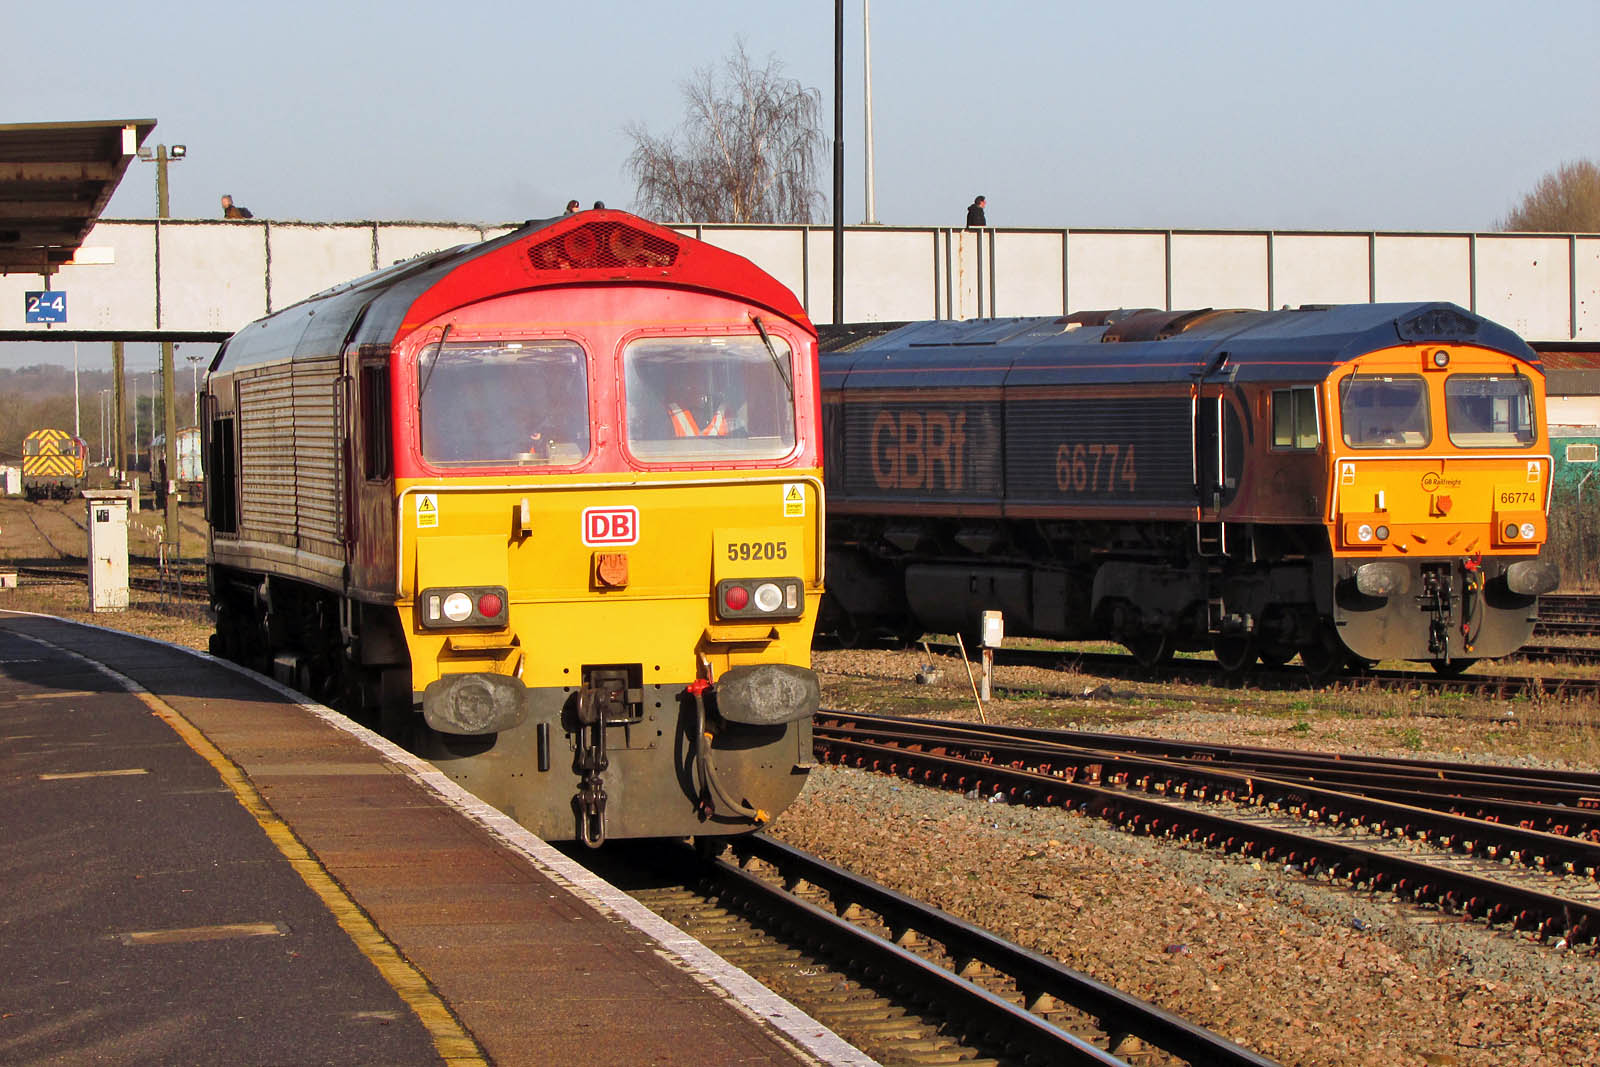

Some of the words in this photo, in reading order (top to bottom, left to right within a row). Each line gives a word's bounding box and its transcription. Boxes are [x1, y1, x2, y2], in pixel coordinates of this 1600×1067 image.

[28, 296, 65, 312] 2-4
[871, 409, 967, 490] GBRf
[1055, 444, 1137, 492] 66774
[1501, 492, 1535, 504] 66774
[592, 514, 630, 538] DB
[728, 541, 787, 561] 59205
